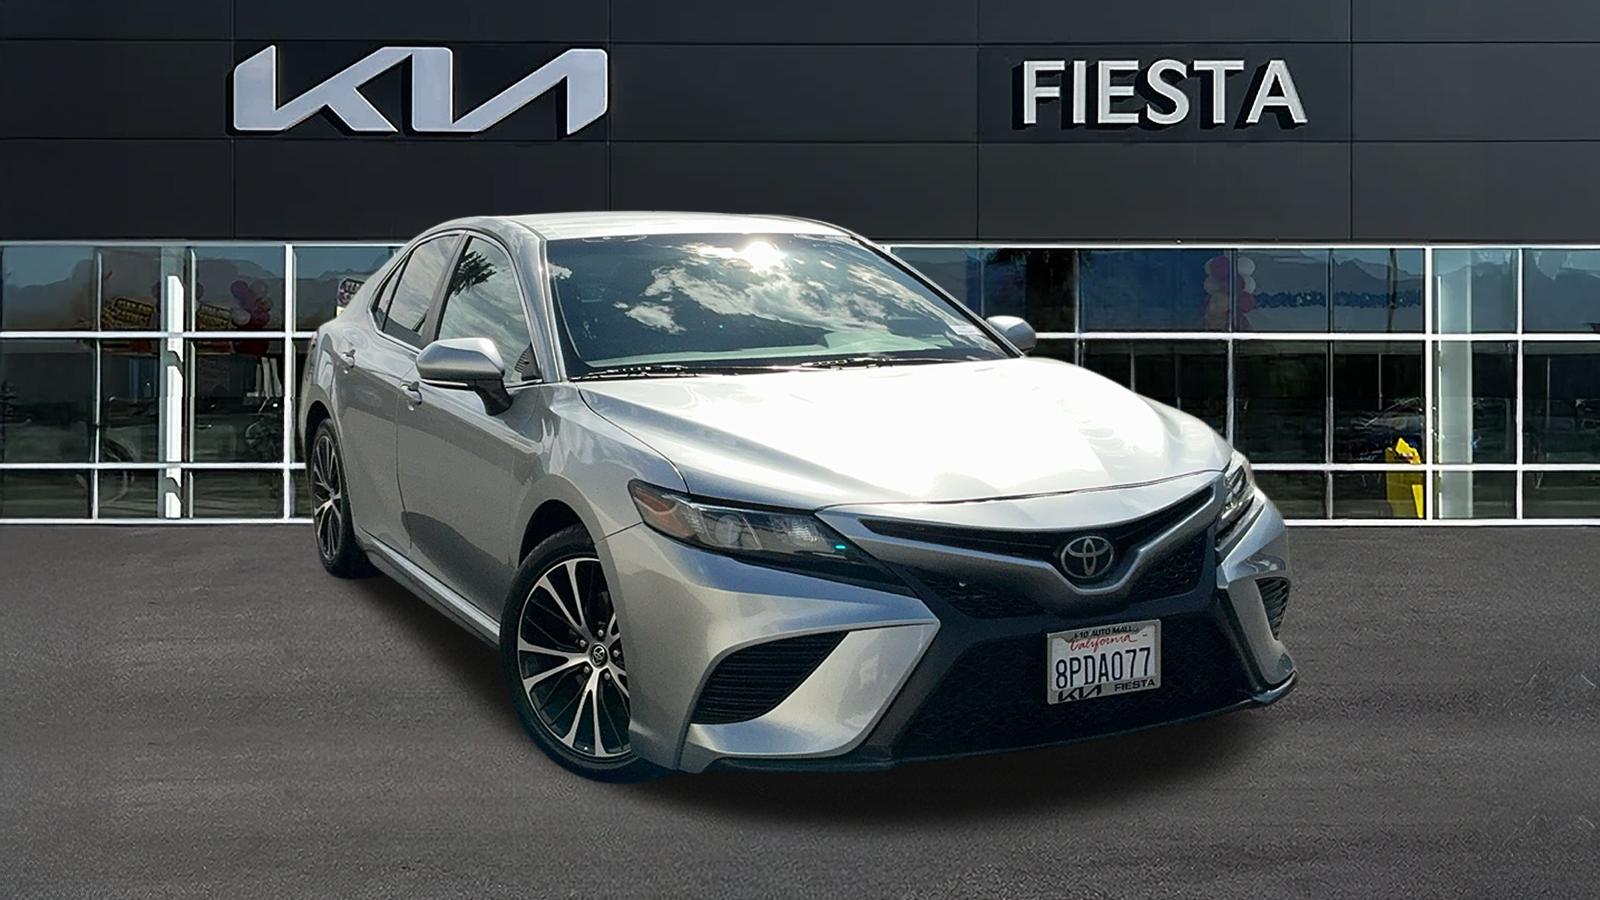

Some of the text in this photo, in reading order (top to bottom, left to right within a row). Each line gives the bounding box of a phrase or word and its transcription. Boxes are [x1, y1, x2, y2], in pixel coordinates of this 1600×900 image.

[1023, 58, 1308, 125] FIESTA
[1091, 628, 1111, 637] AUTO
[1112, 625, 1133, 633] MALL
[1070, 634, 1138, 652] California
[1055, 646, 1151, 689] 8PDA077
[1114, 678, 1156, 692] FIESTA
